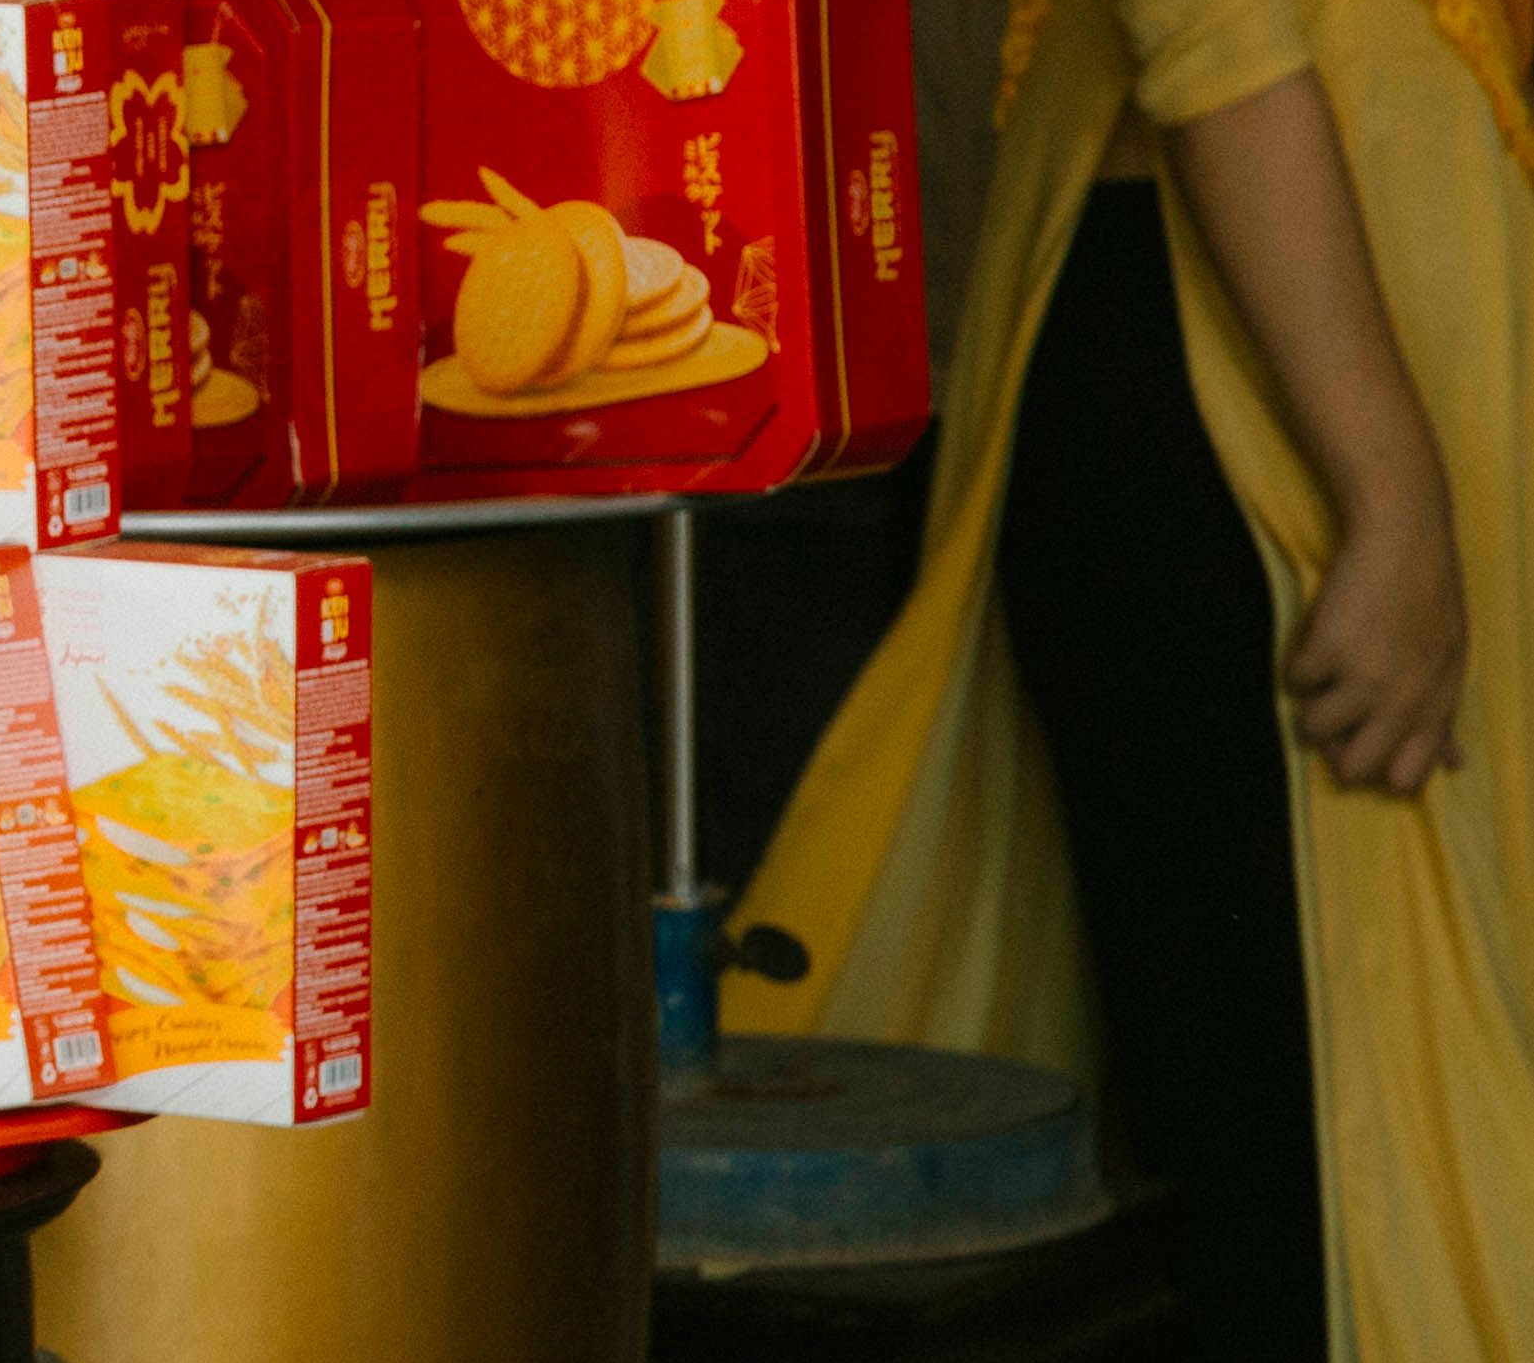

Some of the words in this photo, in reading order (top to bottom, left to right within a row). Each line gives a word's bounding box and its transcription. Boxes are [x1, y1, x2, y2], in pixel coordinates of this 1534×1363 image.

[367, 179, 398, 332] MERRY
[870, 129, 903, 282] MERRY
[147, 262, 181, 429] MERRY
